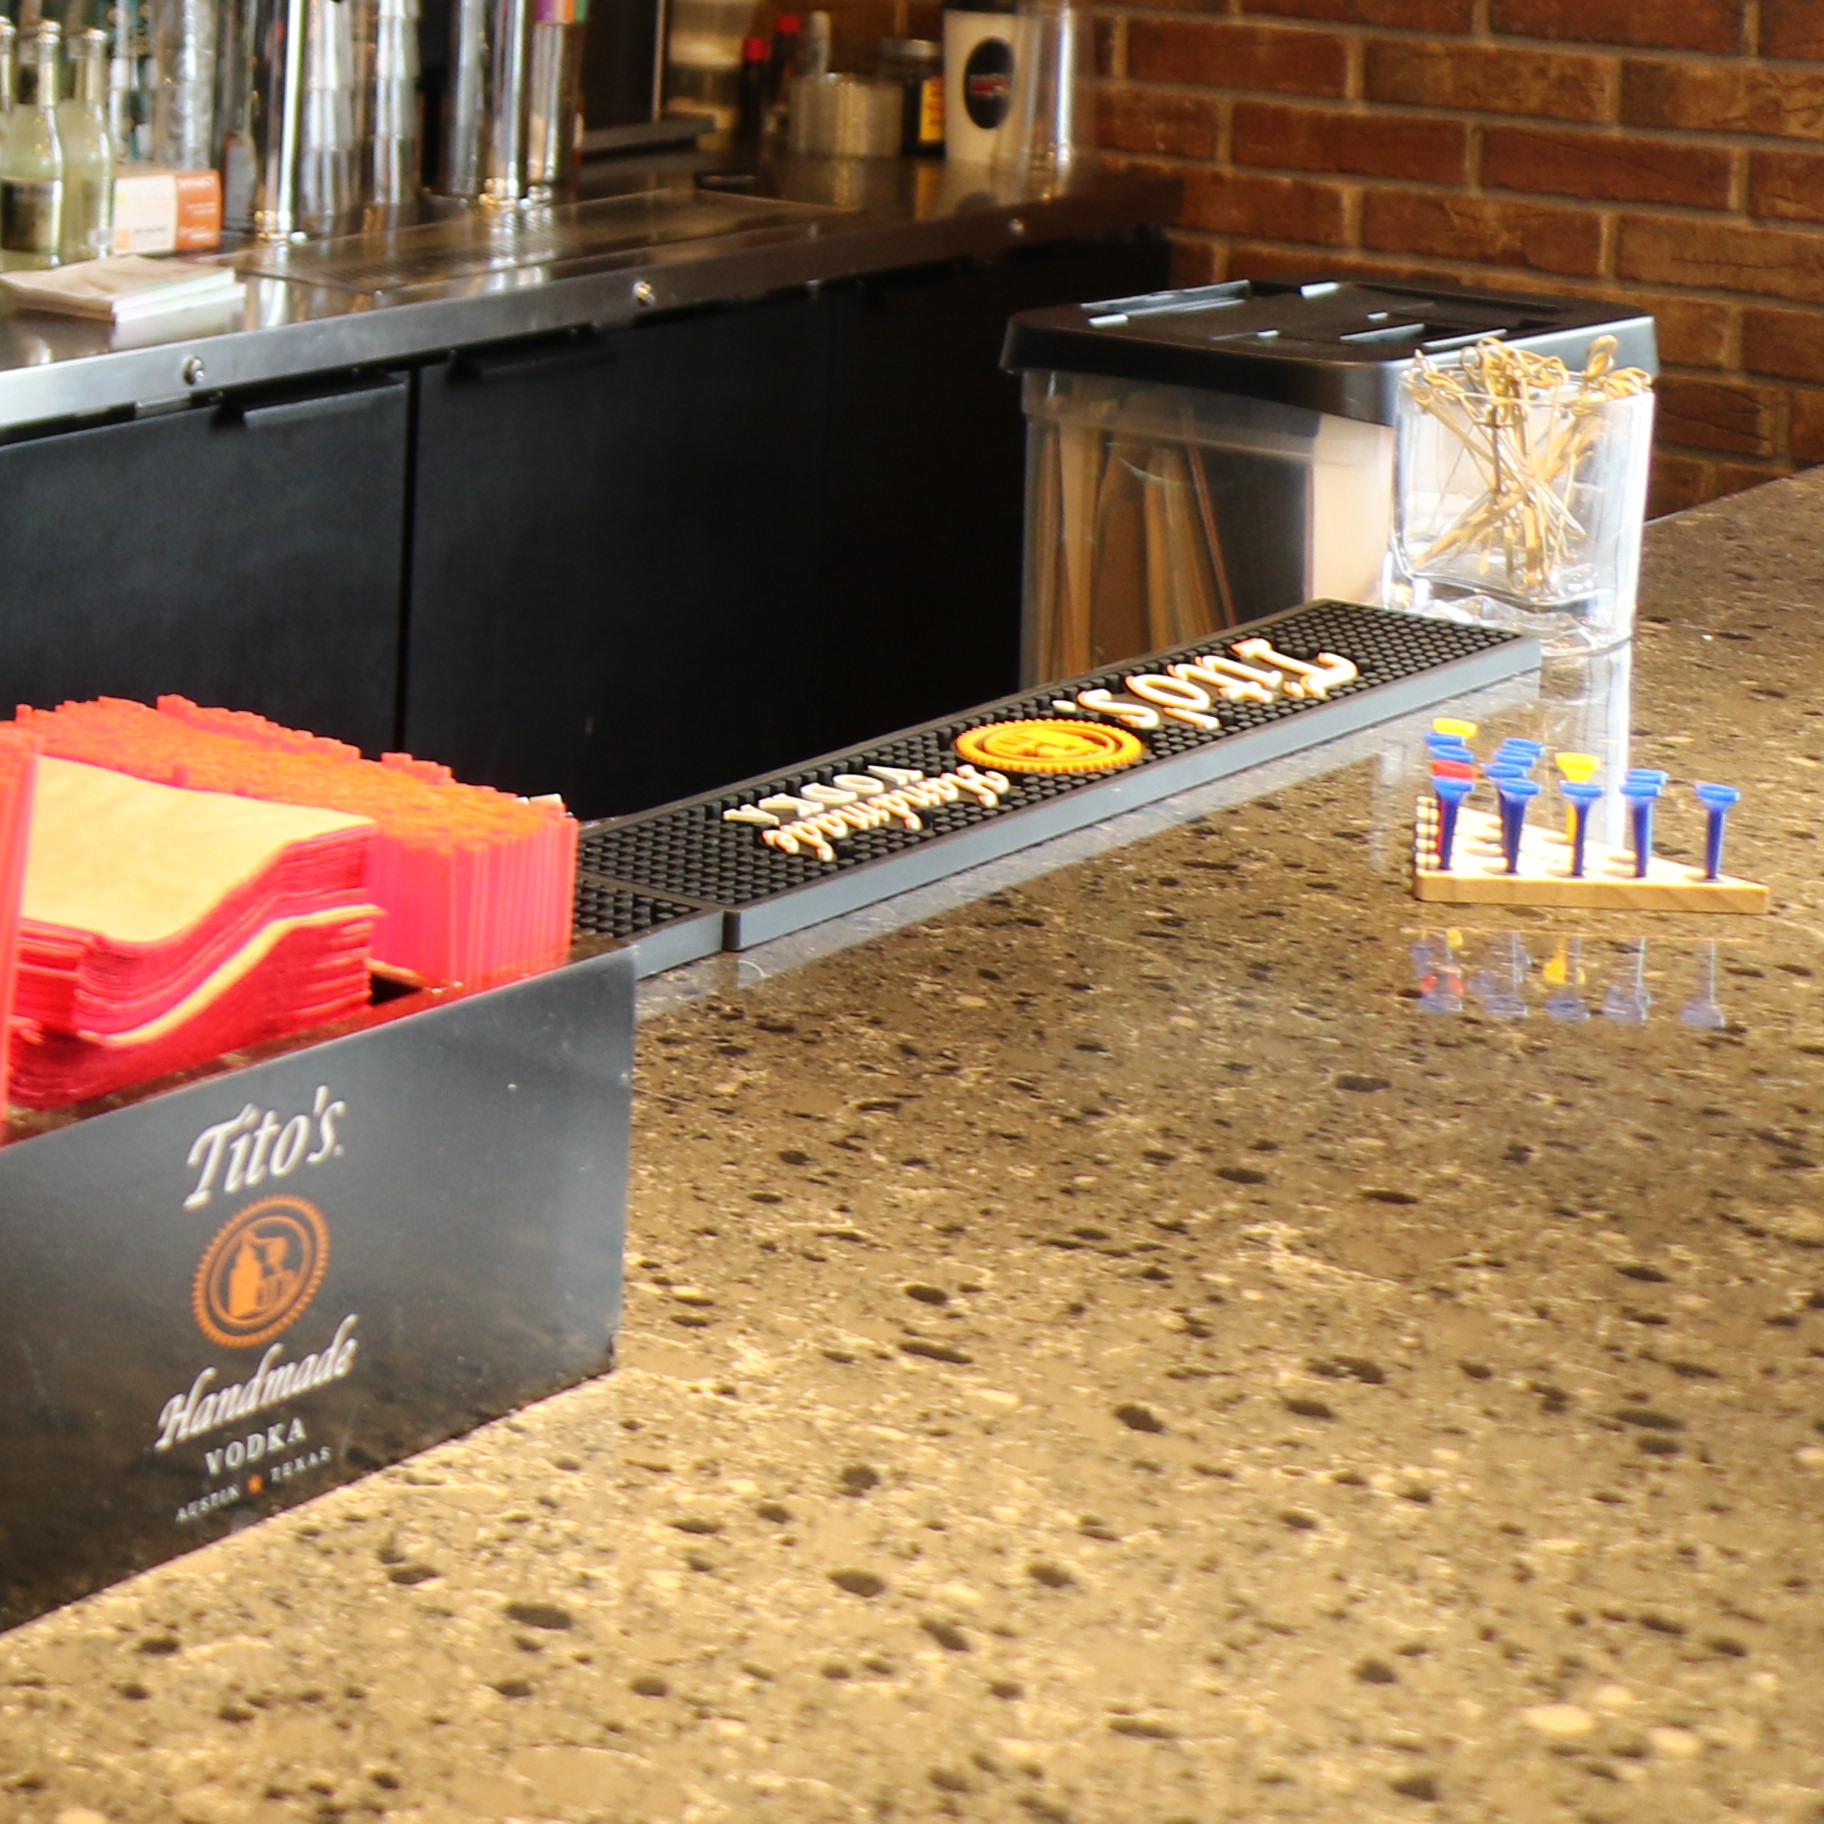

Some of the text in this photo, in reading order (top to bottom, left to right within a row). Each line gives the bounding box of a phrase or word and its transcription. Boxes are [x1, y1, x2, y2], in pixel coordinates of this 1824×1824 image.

[723, 763, 925, 827] VODKA
[761, 764, 1011, 863] Handmade
[183, 1084, 348, 1211] Tito's
[154, 1312, 359, 1453] Handmade
[174, 1444, 332, 1524] AUSTIN TEXAS
[204, 1416, 309, 1477] VODKA
